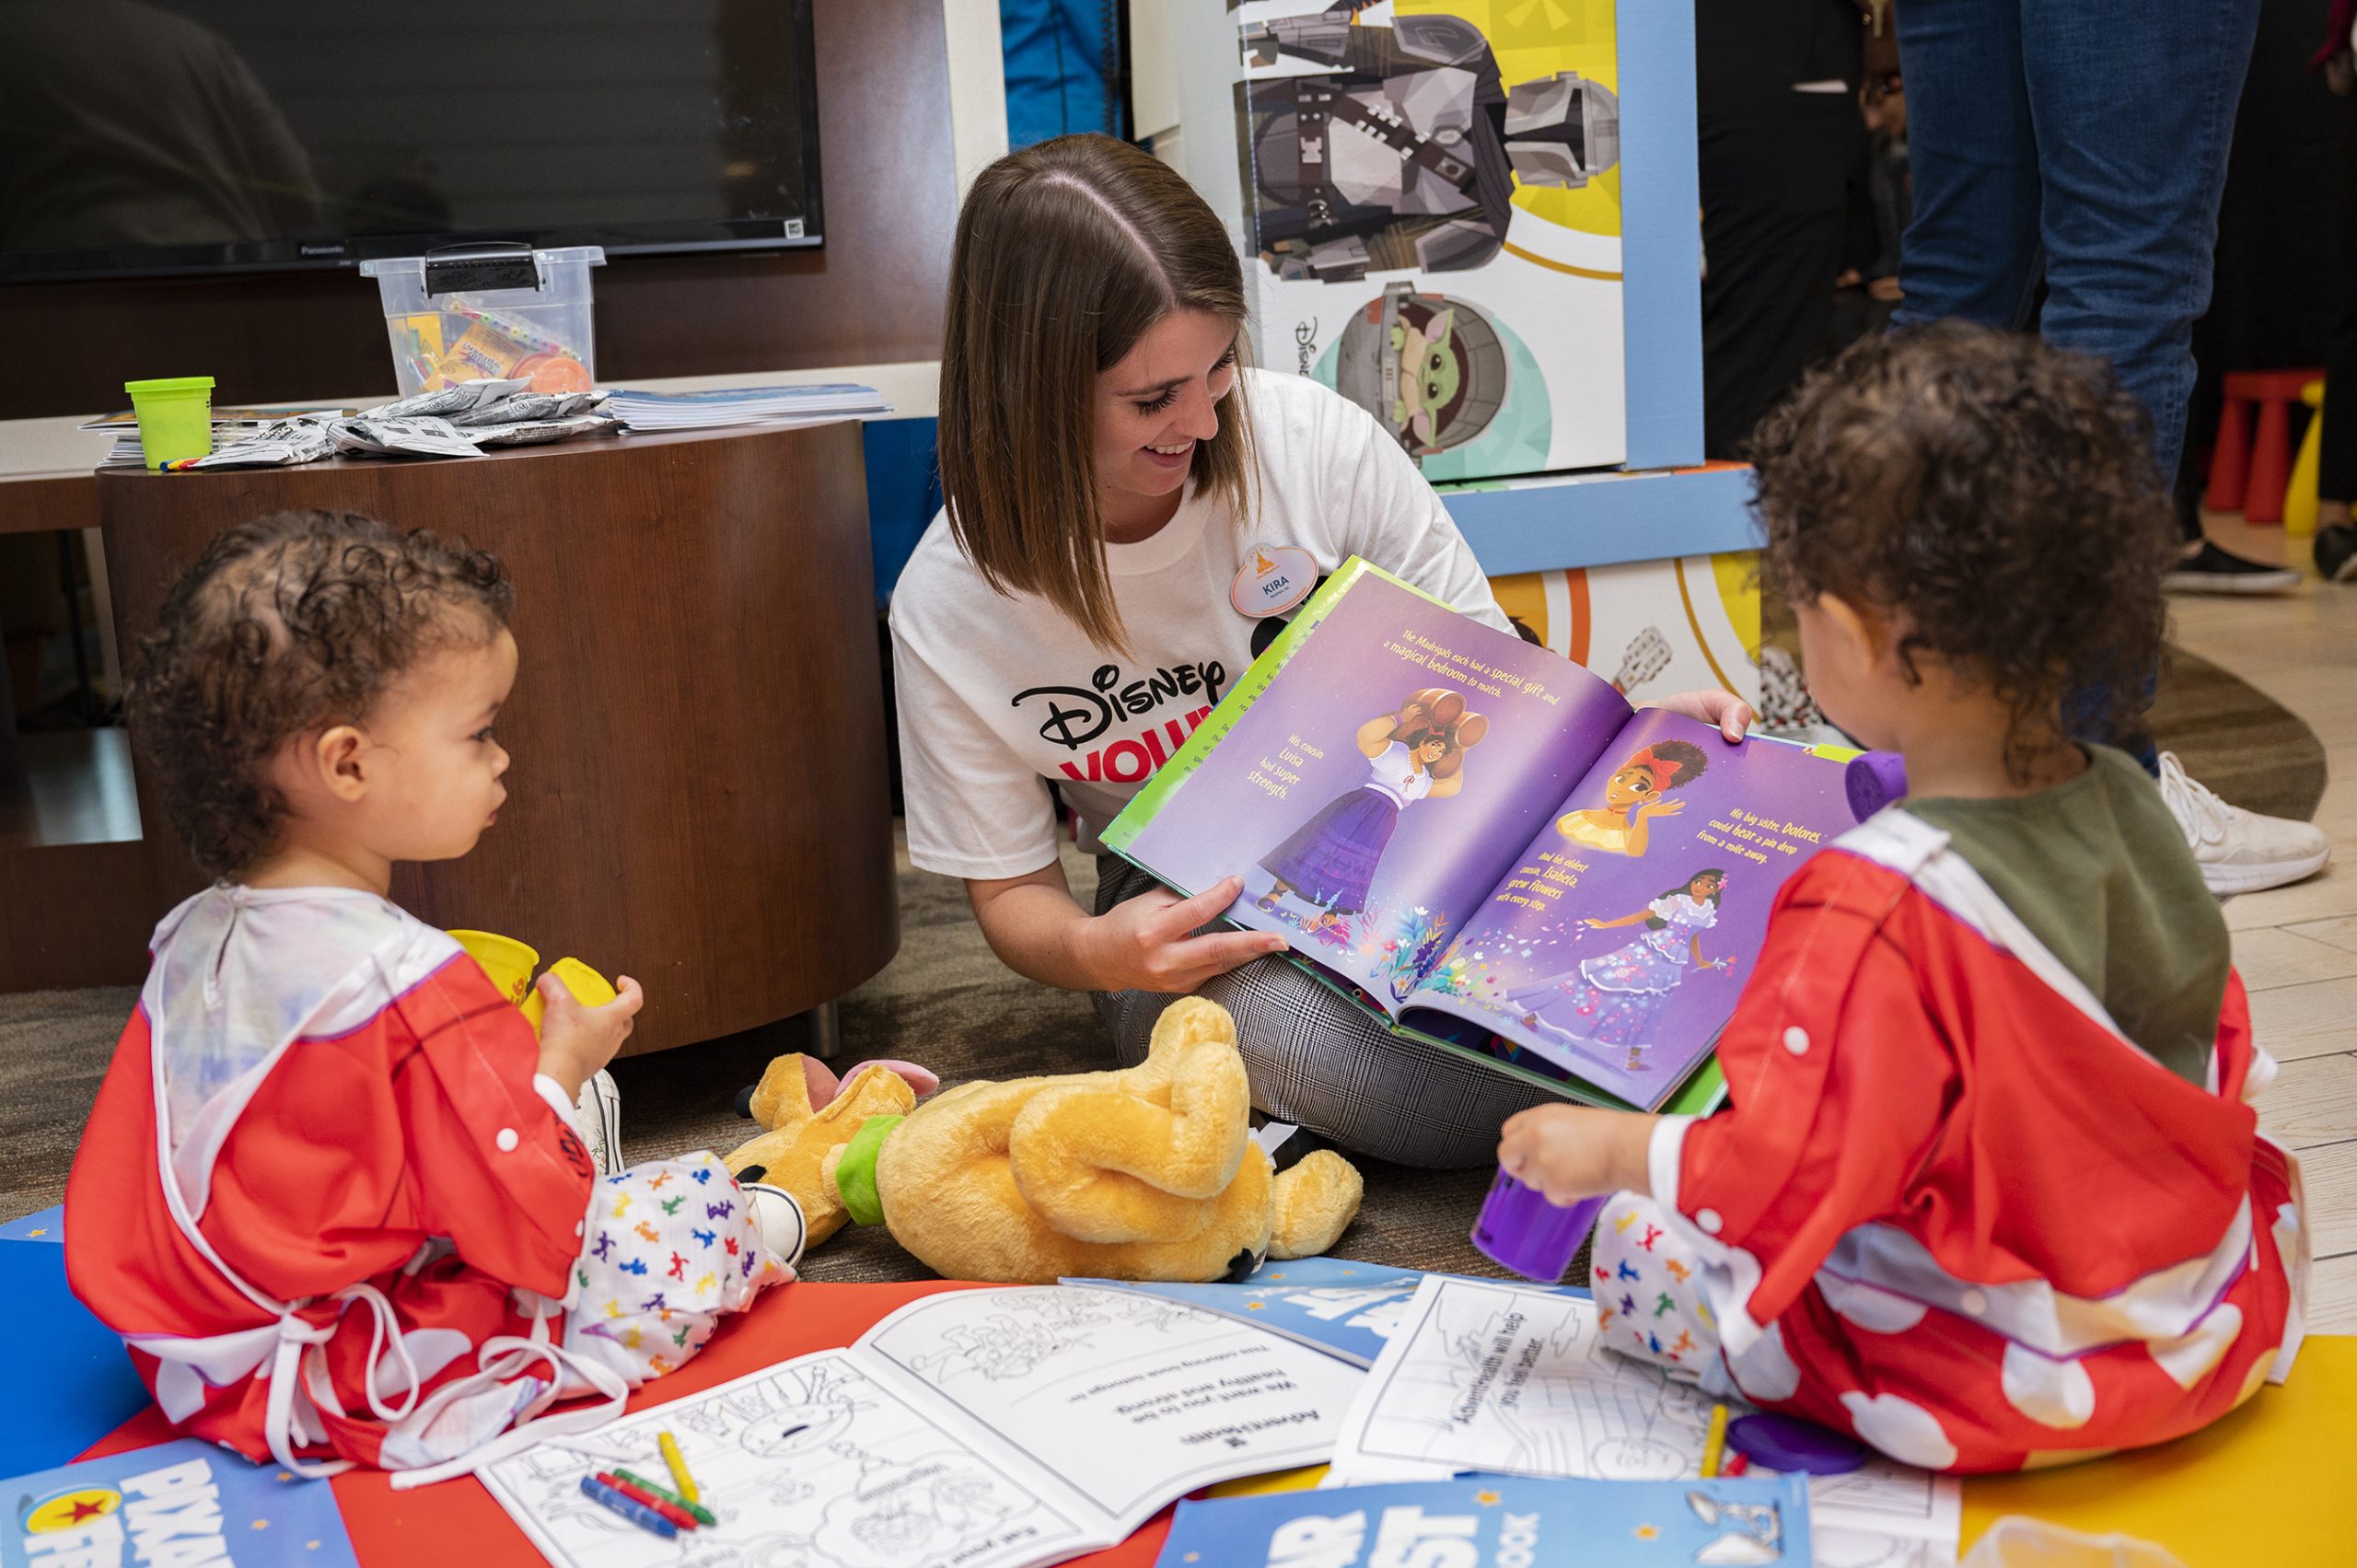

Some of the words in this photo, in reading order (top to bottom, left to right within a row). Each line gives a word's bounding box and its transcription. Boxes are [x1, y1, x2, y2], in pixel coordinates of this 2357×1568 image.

[1295, 316, 1318, 377] Disne
[1261, 575, 1289, 596] KIRA
[1383, 640, 1390, 648] a
[1390, 642, 1429, 667] magical
[1427, 656, 1469, 684] bedroom
[1467, 676, 1477, 687] to
[1477, 681, 1503, 699] match.
[1402, 630, 1415, 642] The
[1415, 635, 1453, 658] Madrigals
[1451, 650, 1469, 667] each
[1469, 659, 1485, 673] had
[1483, 667, 1492, 675] a
[1490, 668, 1527, 690] special
[1523, 680, 1547, 699] gift
[1542, 691, 1561, 706] and
[1278, 747, 1305, 768] Luisa
[1288, 733, 1301, 748] His
[1300, 742, 1324, 760] cousin
[1260, 756, 1278, 772] had
[1273, 766, 1301, 785] super
[1247, 771, 1289, 800] strength.
[1708, 819, 1735, 834] could
[1732, 823, 1758, 841] hear
[1754, 835, 1763, 844] a
[1759, 837, 1778, 849] pin
[1776, 841, 1798, 856] drop
[1729, 807, 1745, 820] His
[1743, 811, 1759, 827] big
[1757, 818, 1782, 832] sister,
[1781, 820, 1822, 845] Dolores,
[1696, 830, 1719, 845] from
[1717, 839, 1726, 847] a
[1724, 842, 1746, 854] mile
[1744, 849, 1769, 865] away.
[1527, 878, 1565, 900] flowers
[1540, 865, 1579, 889] Isabela,
[1527, 899, 1547, 912] step.
[1496, 1311, 1529, 1337] help
[1492, 1335, 1514, 1354] will
[1219, 1366, 1288, 1388] healthy
[1264, 1378, 1299, 1393] We
[1180, 1381, 1217, 1398] and
[1220, 1385, 1262, 1403] want
[1158, 1403, 1183, 1415] to
[1181, 1395, 1214, 1411] you
[1130, 1410, 1160, 1424] be
[1178, 1408, 1321, 1446] AdventHealth
[117, 1457, 238, 1568] PIXA
